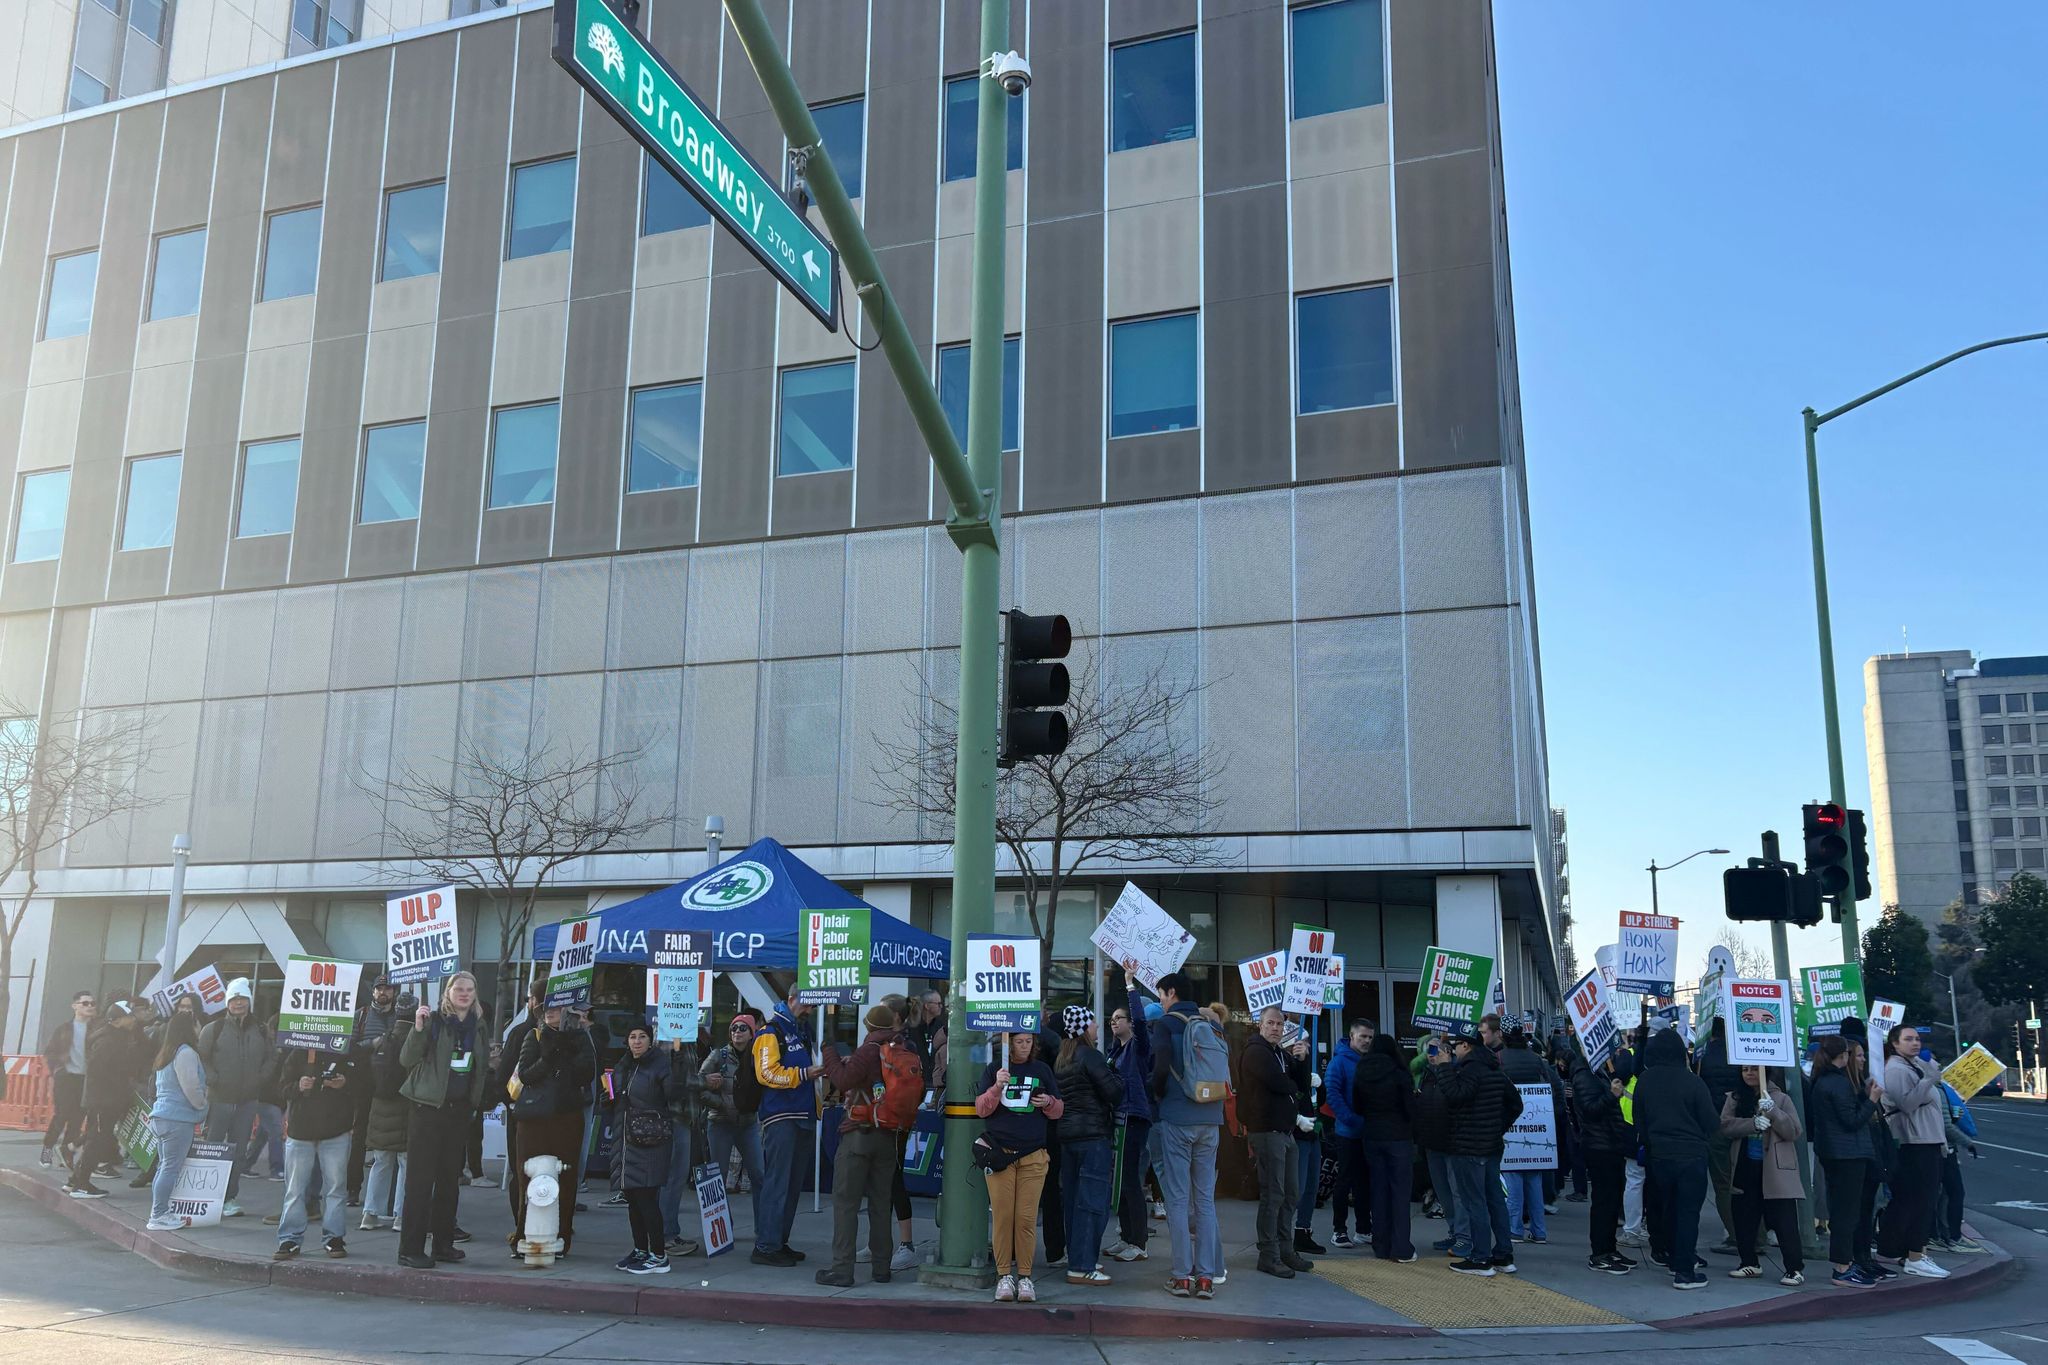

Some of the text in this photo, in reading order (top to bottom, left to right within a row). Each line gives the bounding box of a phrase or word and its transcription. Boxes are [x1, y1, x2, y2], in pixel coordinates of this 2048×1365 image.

[637, 62, 796, 264] Broadway 3700
[401, 892, 442, 926] ULP
[394, 921, 450, 940] Unfair Labor Practice
[812, 914, 850, 930] Unfair
[1626, 915, 1673, 928] ULP STRIKE
[572, 921, 588, 944] ON
[664, 934, 691, 951] FAIR
[812, 931, 849, 946] Labor
[1625, 931, 1665, 952] HONK
[392, 931, 454, 966] STRIKE
[1309, 932, 1324, 954] ON
[557, 944, 594, 971] STRIKE
[654, 951, 704, 966] CONTRACT
[811, 948, 863, 963] Practice
[870, 942, 943, 970] ACUHCP.ORG
[990, 945, 1016, 967] ON
[1437, 955, 1474, 970] Unfair
[1624, 951, 1668, 976] HONK
[310, 962, 337, 986] ON
[1248, 956, 1277, 981] ULP
[1294, 956, 1328, 976] STRIKE
[1810, 969, 1842, 982] Unfair
[809, 966, 859, 988] STRIKE
[975, 972, 1032, 992] STRIKE
[1434, 969, 1470, 985] Labor
[198, 975, 226, 1004] ULP
[1431, 982, 1479, 1001] Practice
[1739, 987, 1774, 995] NOTICE
[1813, 981, 1843, 994] Labor
[291, 988, 351, 1012] STRIKE
[1573, 981, 1598, 1018] ULP
[1815, 992, 1858, 1006] Practice
[1425, 1000, 1473, 1020] STRIKE
[1816, 1006, 1858, 1024] STRIKE
[1881, 1005, 1893, 1018] ON
[290, 1022, 344, 1032] Our Professions
[1584, 1010, 1615, 1056] STRIKE
[1744, 1046, 1775, 1055] thriving
[1523, 1087, 1551, 1095] PATIENTS
[1519, 1125, 1547, 1133] PRISONS
[699, 1178, 725, 1209] STRIKE
[170, 1201, 208, 1216] STRIKE
[710, 1216, 728, 1248] ULP
